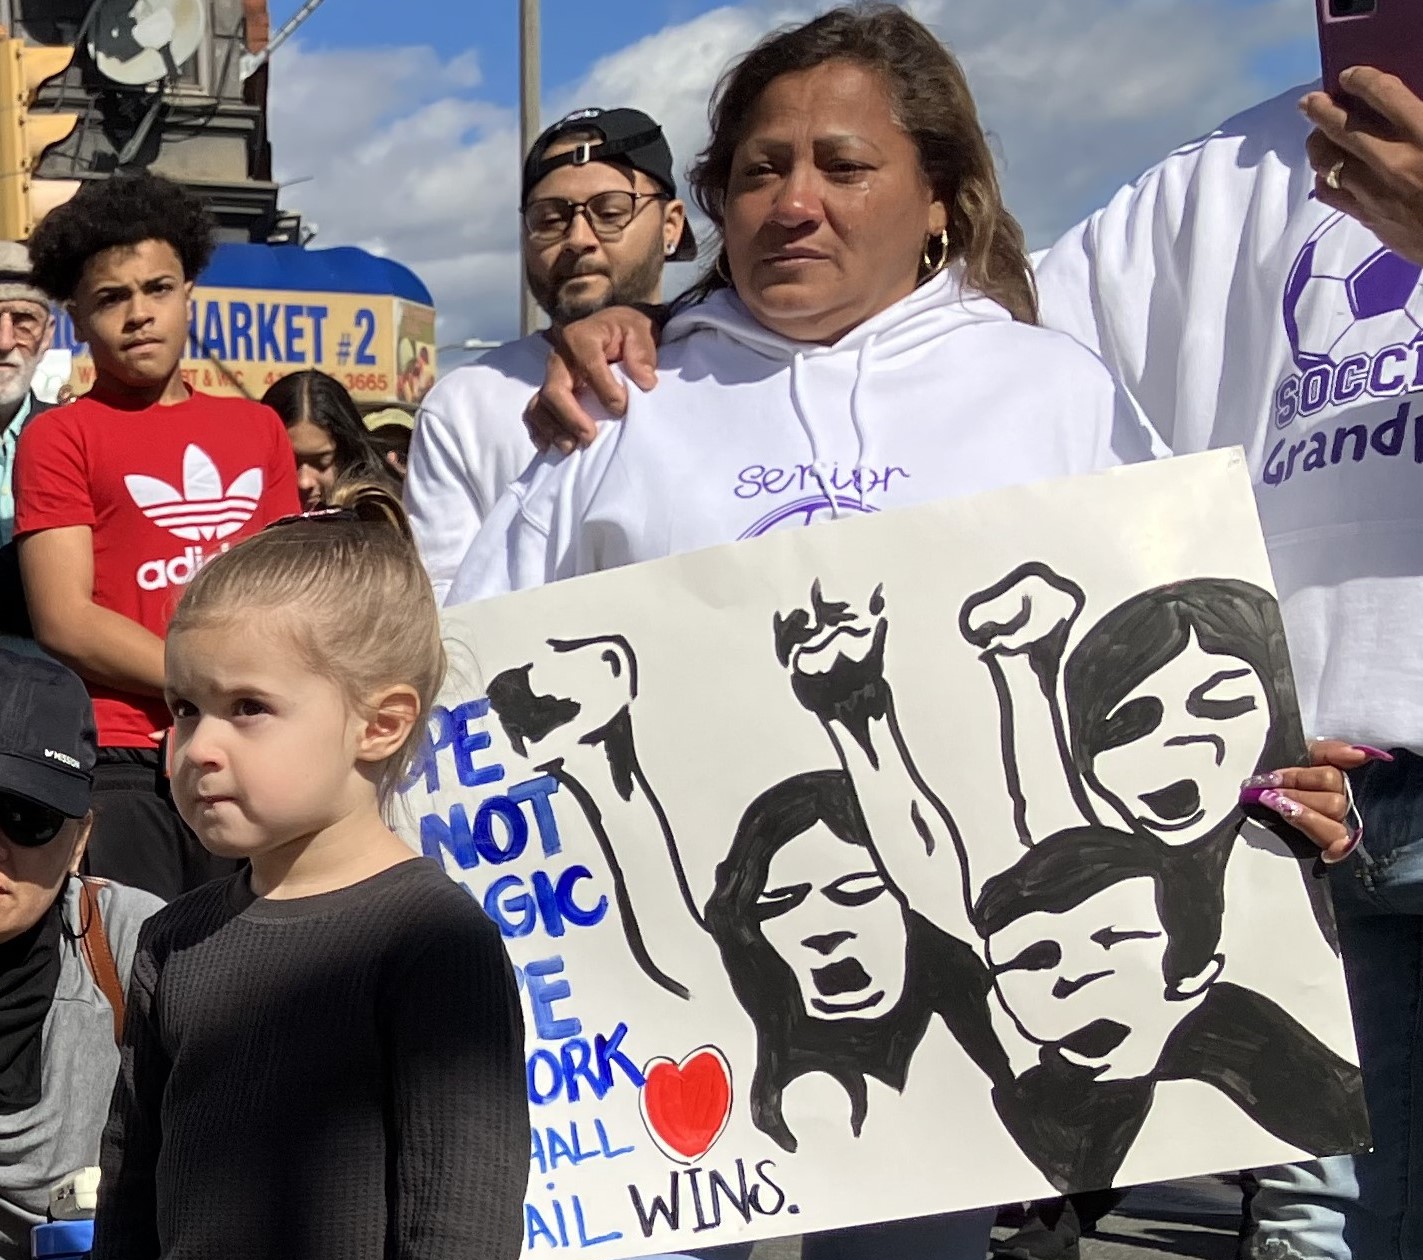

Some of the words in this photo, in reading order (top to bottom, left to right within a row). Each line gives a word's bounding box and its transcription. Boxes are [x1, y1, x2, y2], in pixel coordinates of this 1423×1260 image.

[347, 374, 388, 391] 3665
[137, 542, 229, 590] adi
[395, 697, 506, 794] PE
[420, 774, 562, 870] NOT
[460, 865, 609, 938] GIC
[526, 1021, 647, 1106] ORK
[531, 1118, 635, 1174] HALL
[628, 1157, 801, 1238] WINS.
